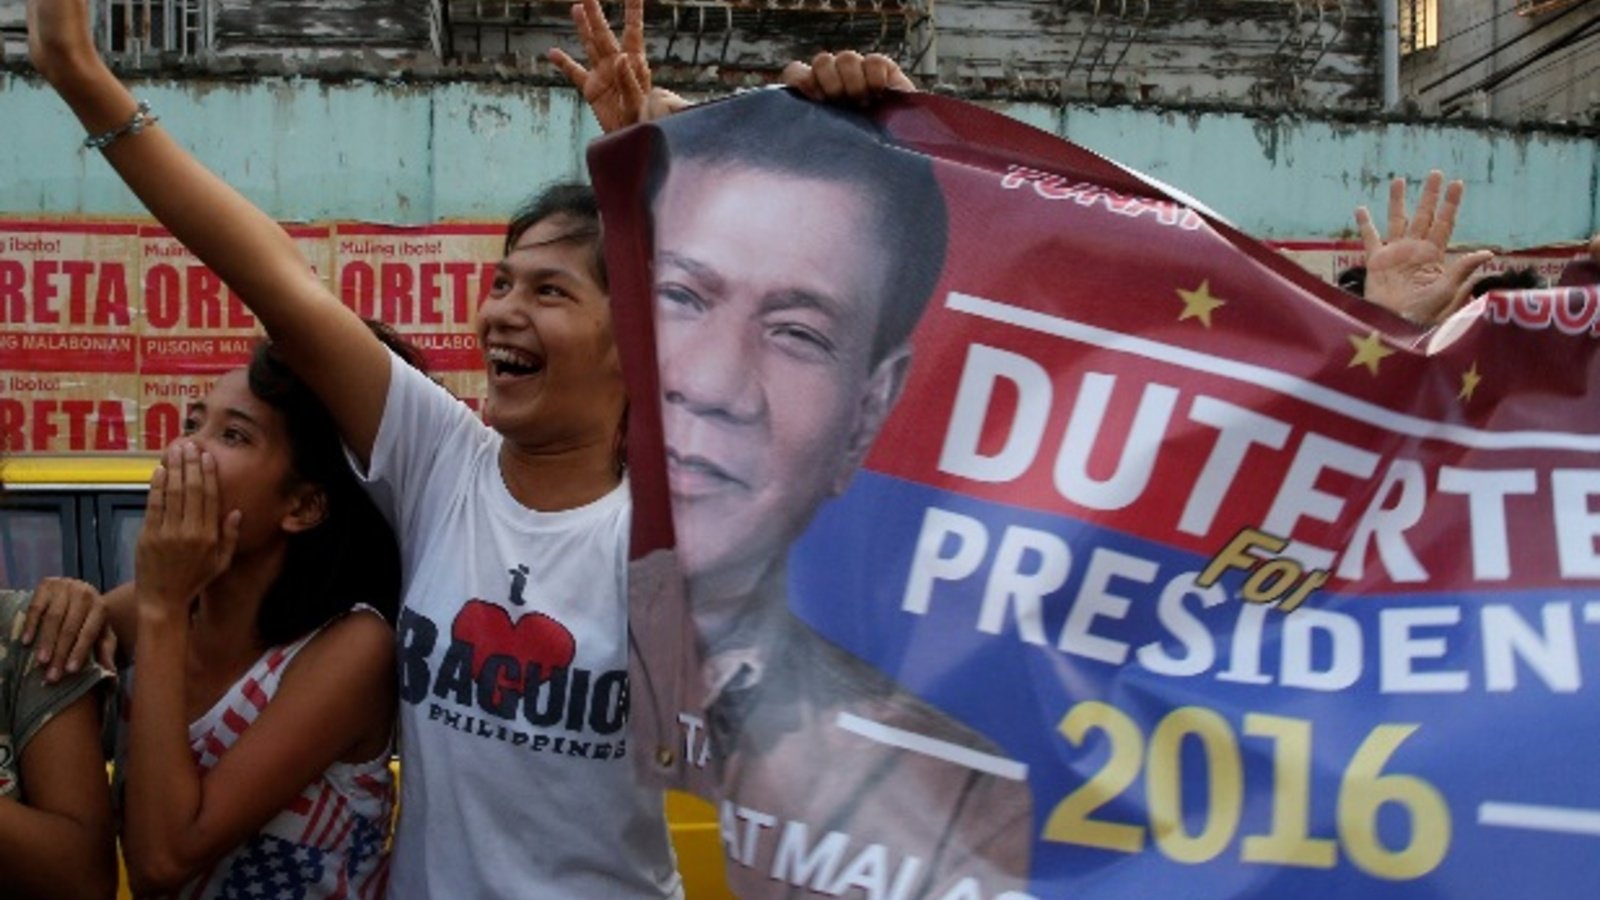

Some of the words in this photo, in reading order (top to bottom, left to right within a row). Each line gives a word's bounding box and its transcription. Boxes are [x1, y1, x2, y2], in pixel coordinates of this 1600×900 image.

[22, 335, 131, 351] MALABONIAN
[146, 340, 214, 355] PUSONG
[144, 383, 200, 398] Muling
[937, 343, 1600, 583] DUTERTE
[902, 506, 1600, 693] PRESIDEN
[1193, 524, 1333, 615] For
[398, 605, 631, 736] BAGUIO
[428, 703, 626, 761] PHILIPPINES
[1041, 700, 1452, 880] 2016
